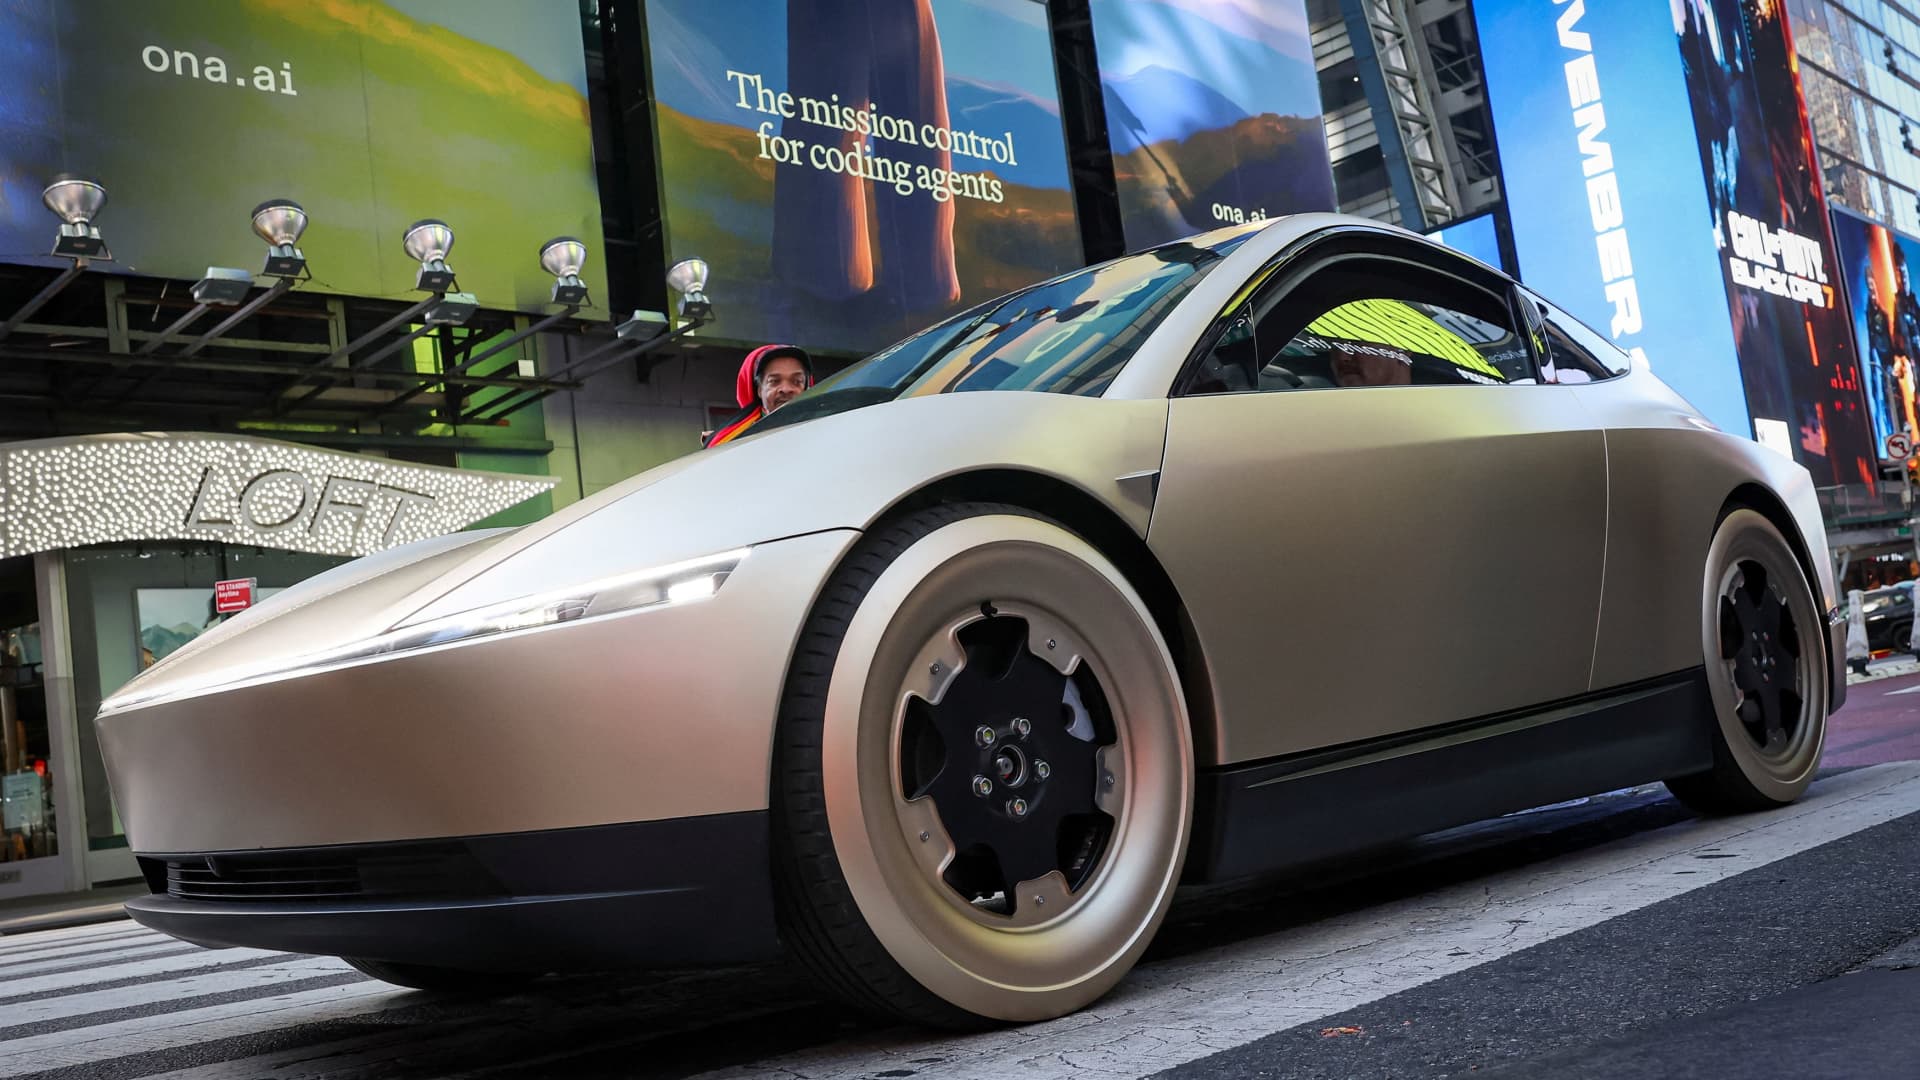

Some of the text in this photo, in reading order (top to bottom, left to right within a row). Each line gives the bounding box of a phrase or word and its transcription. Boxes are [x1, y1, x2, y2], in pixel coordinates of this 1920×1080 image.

[142, 45, 297, 96] ona.ai
[726, 70, 1018, 167] The mission control
[756, 121, 1004, 203] for coding agents
[1552, 0, 1642, 339] VEMBER
[1728, 211, 1777, 268] CALL
[1729, 257, 1834, 310] BLACK OPS 7
[183, 466, 435, 545] LOFT
